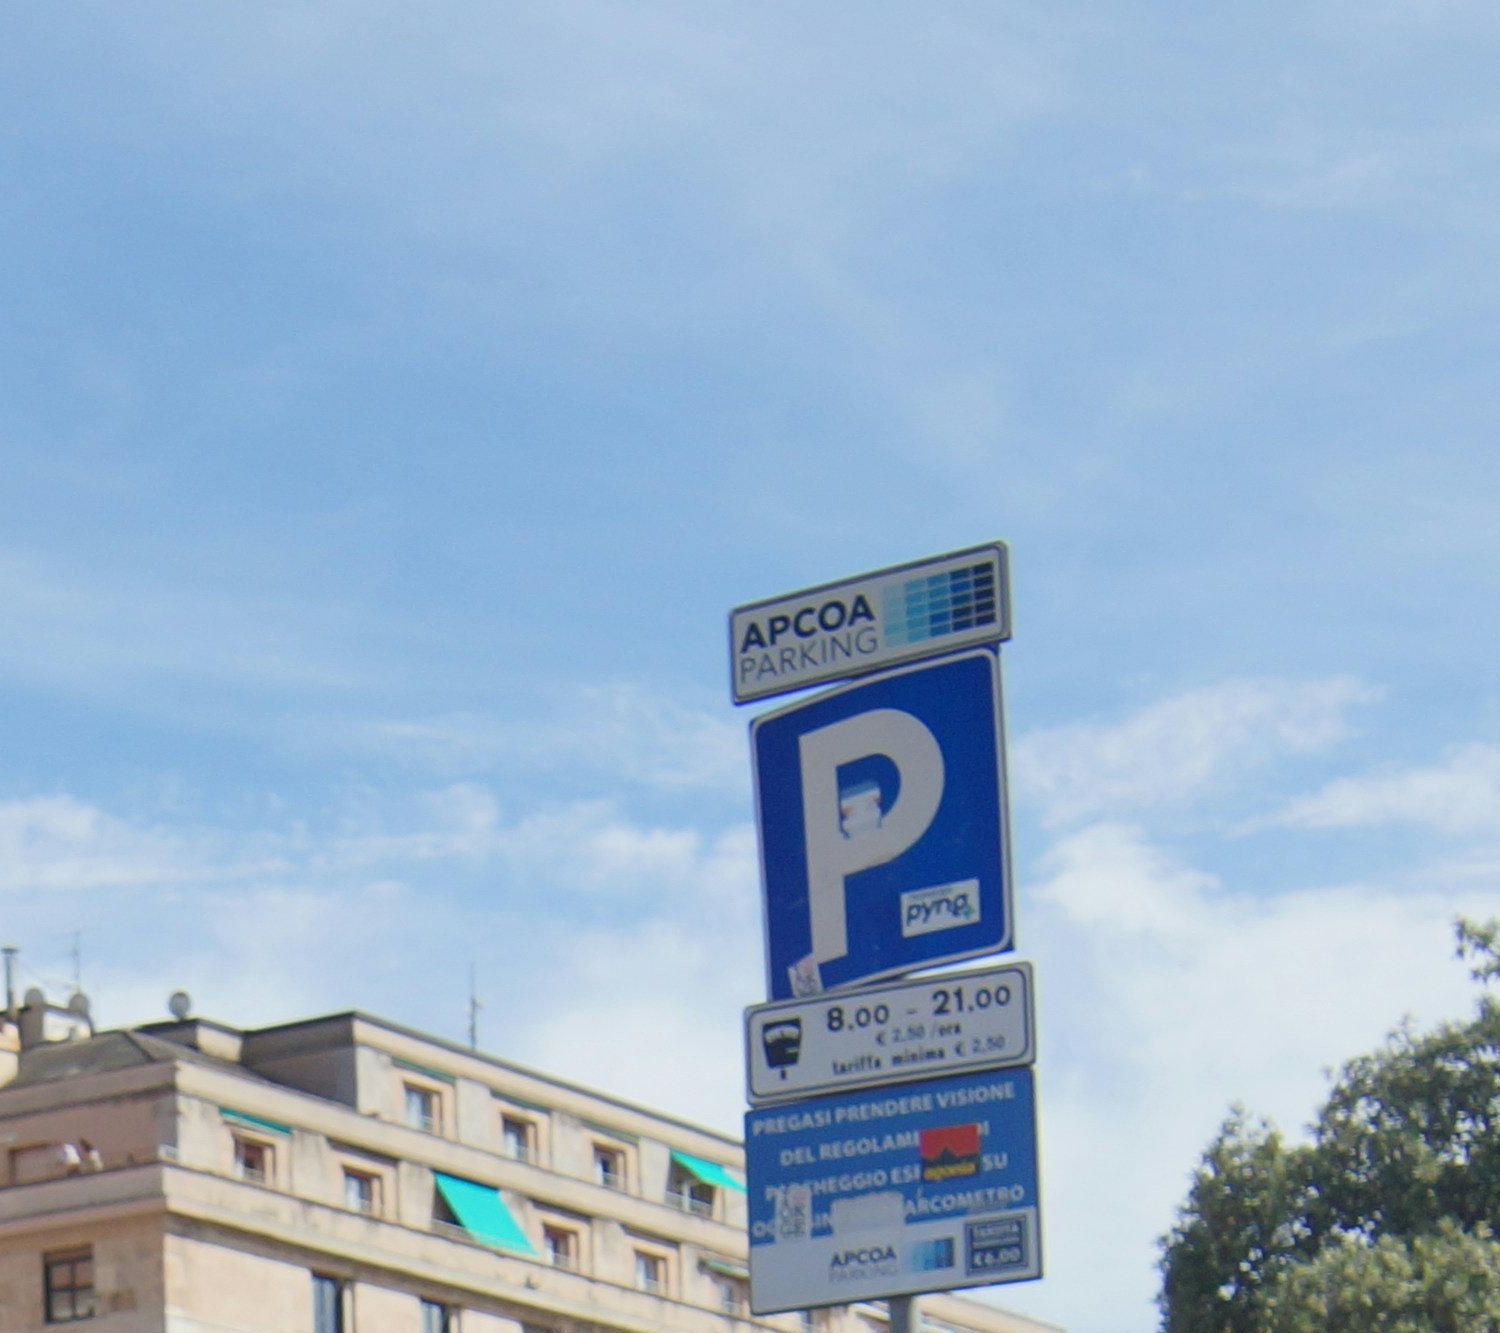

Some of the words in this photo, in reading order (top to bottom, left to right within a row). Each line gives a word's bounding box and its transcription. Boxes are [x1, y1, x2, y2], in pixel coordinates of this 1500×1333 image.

[740, 594, 876, 653] APCOA
[741, 627, 879, 683] PARKING
[798, 707, 946, 965] P
[827, 1005, 890, 1031] 8.00
[932, 986, 1012, 1017] 21.00
[833, 1053, 882, 1076] tariffa
[753, 1109, 832, 1136] PREGASI
[836, 1092, 933, 1124] PRENDERE
[936, 1081, 1016, 1109] VISIONE
[780, 1145, 816, 1166] DEL
[982, 1152, 1008, 1171] SU
[903, 1184, 1025, 1216] ARCOMETRO
[830, 1245, 897, 1269] APCOA
